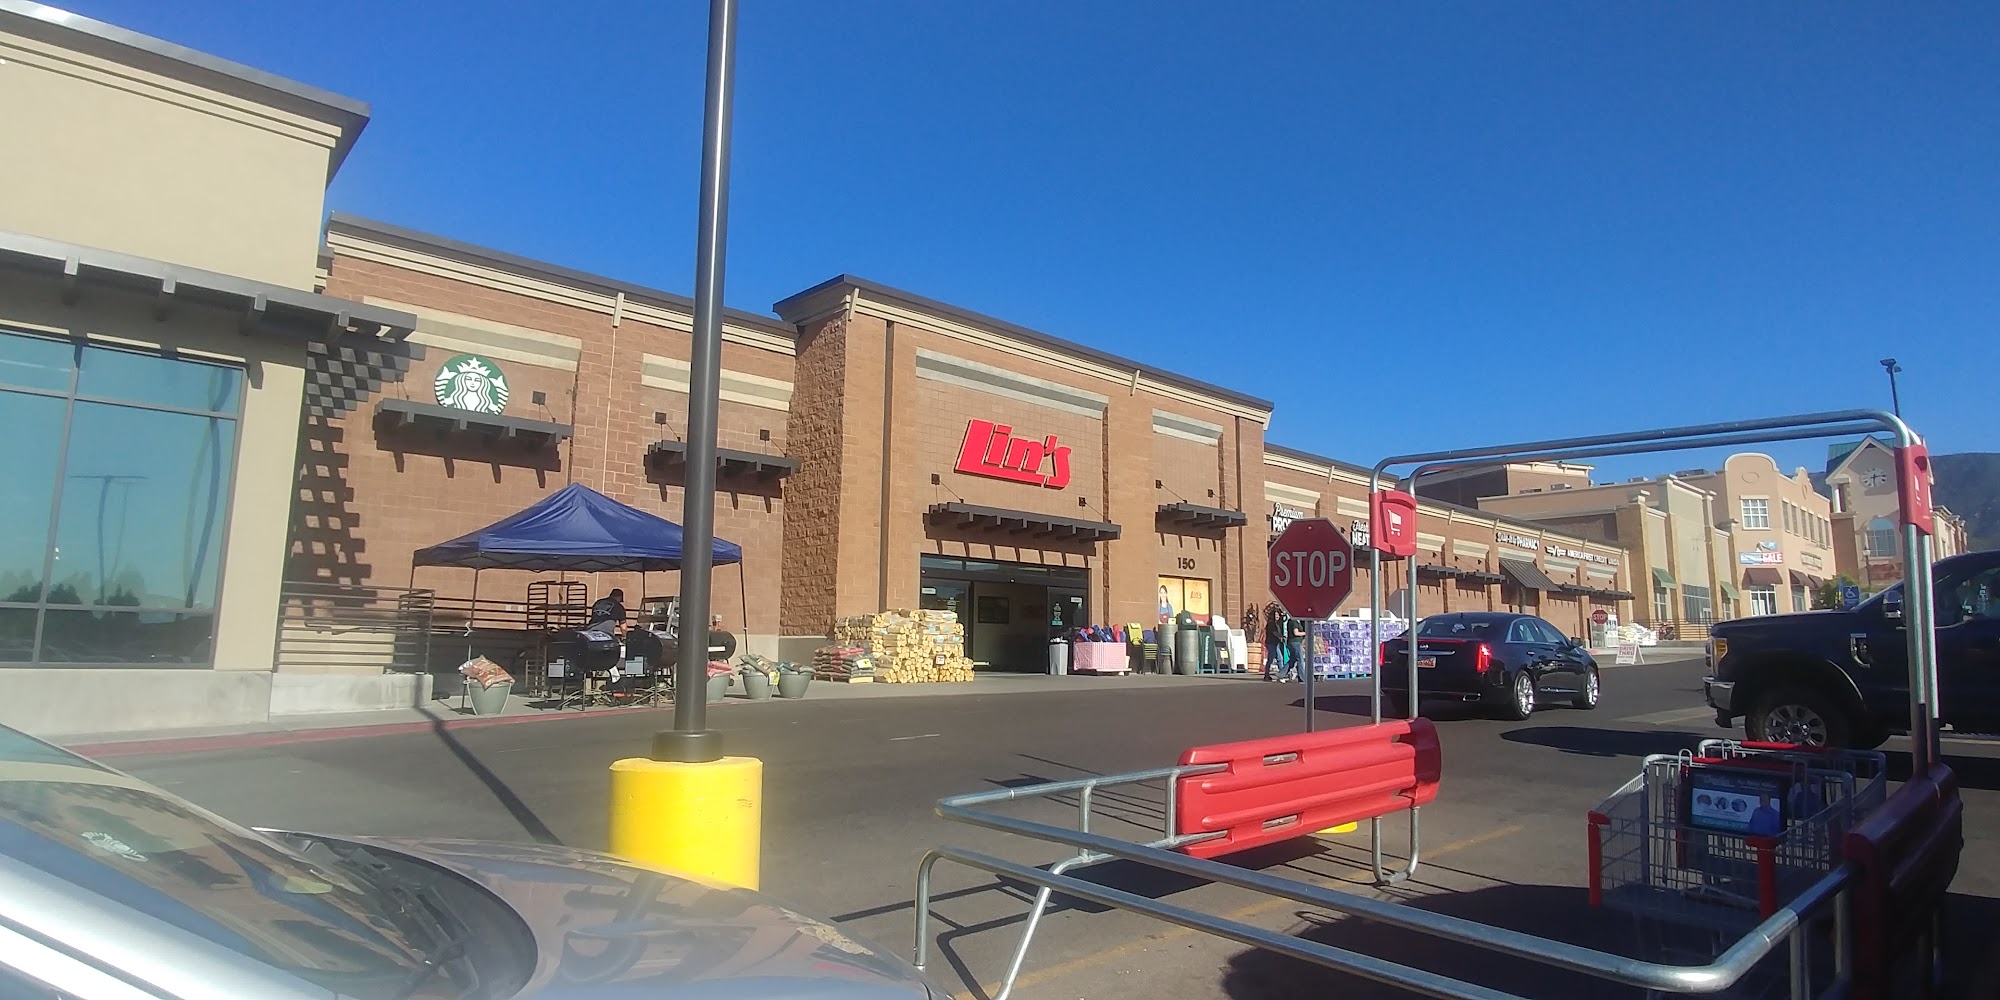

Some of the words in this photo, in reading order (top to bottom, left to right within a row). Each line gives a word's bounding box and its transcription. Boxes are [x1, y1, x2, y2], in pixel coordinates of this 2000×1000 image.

[954, 419, 1072, 490] Lin's
[1274, 502, 1304, 519] Premium
[1273, 517, 1291, 532] PRO
[1178, 557, 1196, 570] 150
[1763, 553, 1782, 563] SALE
[1275, 551, 1346, 587] STOP
